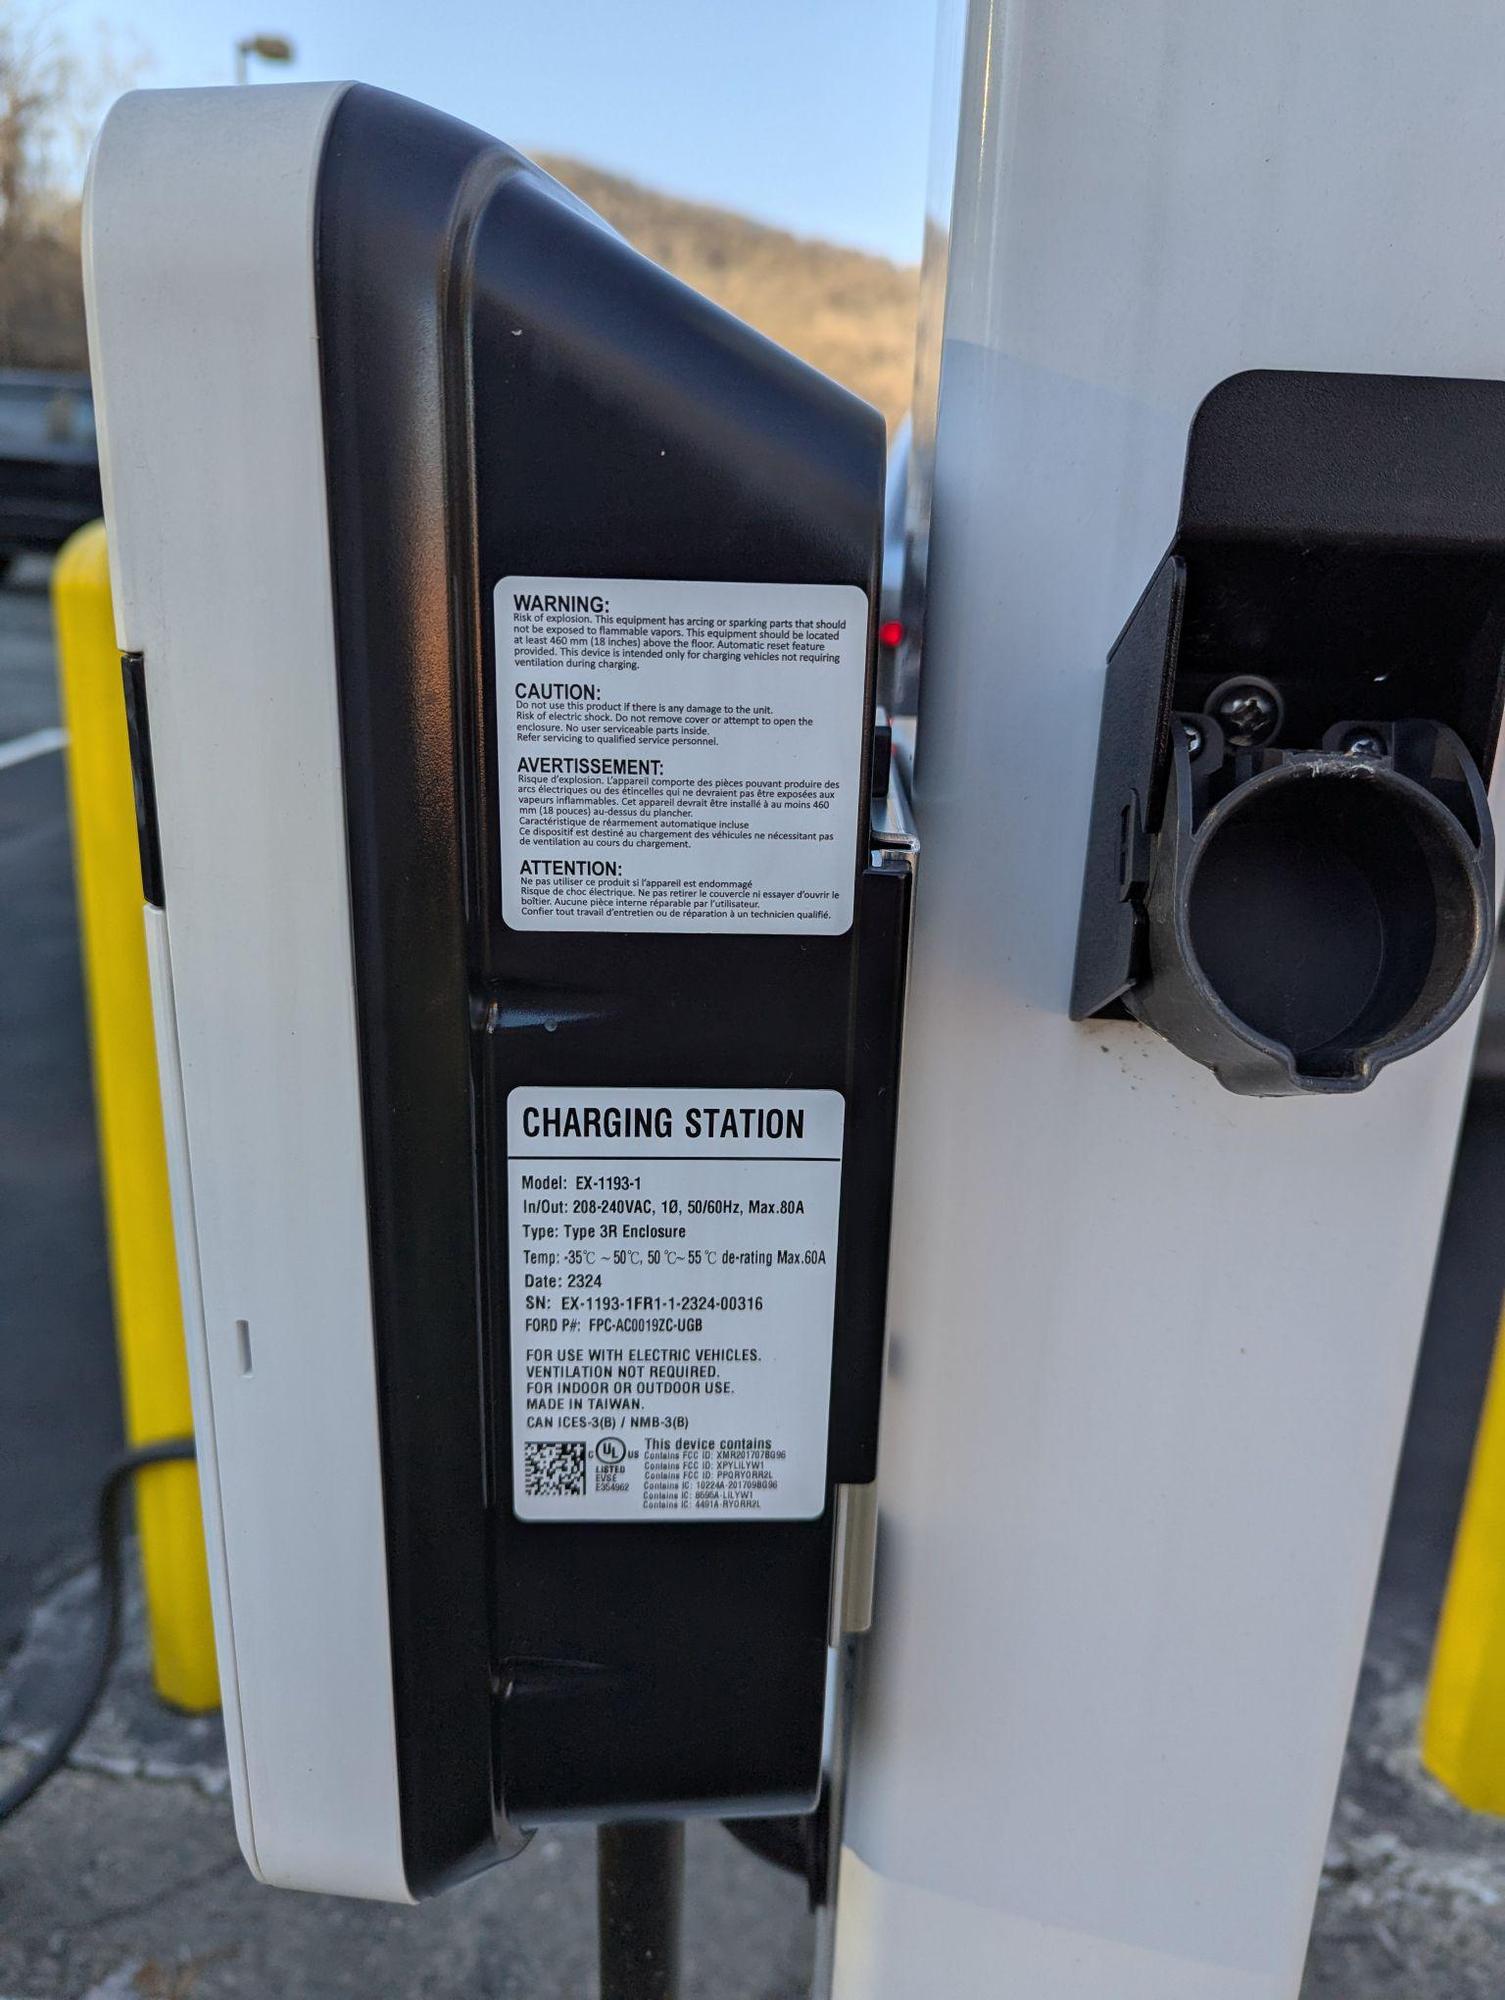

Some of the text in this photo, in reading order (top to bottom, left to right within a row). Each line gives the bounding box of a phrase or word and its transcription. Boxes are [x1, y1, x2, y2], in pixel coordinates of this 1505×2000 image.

[512, 593, 609, 614] WARNING:
[513, 612, 532, 621] Risk
[533, 612, 544, 621] of
[545, 613, 593, 624] explosion.
[593, 614, 614, 623] This
[615, 616, 667, 626] equipment
[668, 616, 685, 625] has
[686, 617, 715, 627] arcing
[728, 617, 768, 628] sparking
[769, 620, 793, 629] parts
[794, 619, 814, 628] that
[815, 620, 846, 629] should
[531, 624, 544, 633] be
[545, 624, 585, 635] exposed
[598, 625, 649, 635] flammable
[650, 629, 684, 637] vapors.
[684, 627, 706, 636] This
[706, 629, 758, 639] equipment
[758, 629, 790, 639] should
[791, 630, 804, 639] be
[805, 630, 840, 640] located
[525, 635, 548, 644] least
[549, 635, 568, 644] 460
[589, 636, 606, 647] (18
[607, 637, 641, 647] inches)
[642, 638, 672, 647] above
[672, 638, 690, 647] the
[690, 639, 715, 648] floor.
[716, 639, 766, 649] Automatic
[766, 642, 790, 650] reset
[790, 641, 826, 651] feature
[513, 657, 640, 670] ventilation during charging.
[514, 682, 600, 701] CAUTION:
[515, 700, 529, 709] Do
[566, 701, 584, 710] this
[584, 701, 623, 712] product
[623, 702, 631, 711] if
[631, 703, 657, 711] there
[658, 704, 667, 712] is
[685, 704, 722, 714] damage
[735, 705, 751, 713] the
[752, 706, 773, 714] unit.
[516, 732, 541, 741] Refer
[542, 734, 584, 743] servicing
[596, 734, 636, 744] qualified
[636, 736, 670, 744] service
[671, 736, 719, 746] personnel.
[516, 756, 663, 775] AVERTISSEMENT:
[538, 806, 556, 815] (18
[555, 806, 591, 816] pouces)
[591, 807, 638, 816] au-dessus
[638, 808, 651, 816] du
[652, 808, 693, 818] plancher.
[518, 837, 531, 845] de
[531, 837, 581, 846] ventilation
[621, 838, 634, 847] du
[635, 839, 691, 849] chargement.
[519, 859, 622, 876] ATTENTION:
[522, 1105, 804, 1139] CHARGING STATION
[521, 1174, 640, 1191] Model: EX-1193-1
[523, 1198, 568, 1214] In/Out:
[572, 1198, 656, 1216] 208-240VAC,
[687, 1199, 744, 1216] 50/60Hz,
[747, 1199, 805, 1215] Max.80A
[521, 1223, 686, 1241] Type: Type 3R Enclosure
[522, 1249, 560, 1266] Temp:
[721, 1249, 773, 1267] de-rating
[776, 1249, 827, 1265] Max.60A
[524, 1273, 602, 1288] Date: 2324
[525, 1293, 763, 1312] SN: EX-1193-1FR1-1-2324-00316
[525, 1317, 558, 1332] FORD
[561, 1317, 580, 1332] P#:
[525, 1347, 762, 1362] FOR USE WITH ELECTRIC VEHICLES.
[525, 1364, 720, 1379] VENTILATION NOT REQUIRED.
[526, 1380, 735, 1395] FOR INDOOR OR OUTDOOR USE.
[526, 1397, 644, 1410] MADE IN TAIWAN.
[526, 1415, 553, 1429] CAN
[557, 1415, 616, 1430] ICES-3(B)
[630, 1415, 689, 1430] NMB-3(B)
[644, 1436, 772, 1450] This device contains
[643, 1449, 680, 1460] Contains
[681, 1449, 699, 1460] FCC
[701, 1449, 714, 1460] ID:
[595, 1464, 625, 1474] LISTED
[643, 1459, 680, 1470] Contains
[681, 1460, 699, 1470] FCC
[701, 1460, 713, 1470] ID:
[595, 1473, 617, 1482] EVSE
[643, 1469, 680, 1479] Contains
[681, 1469, 699, 1480] FCC
[701, 1470, 714, 1480] ID:
[643, 1479, 679, 1490] Contains
[642, 1489, 679, 1499] Contains
[642, 1498, 678, 1510] Contains
